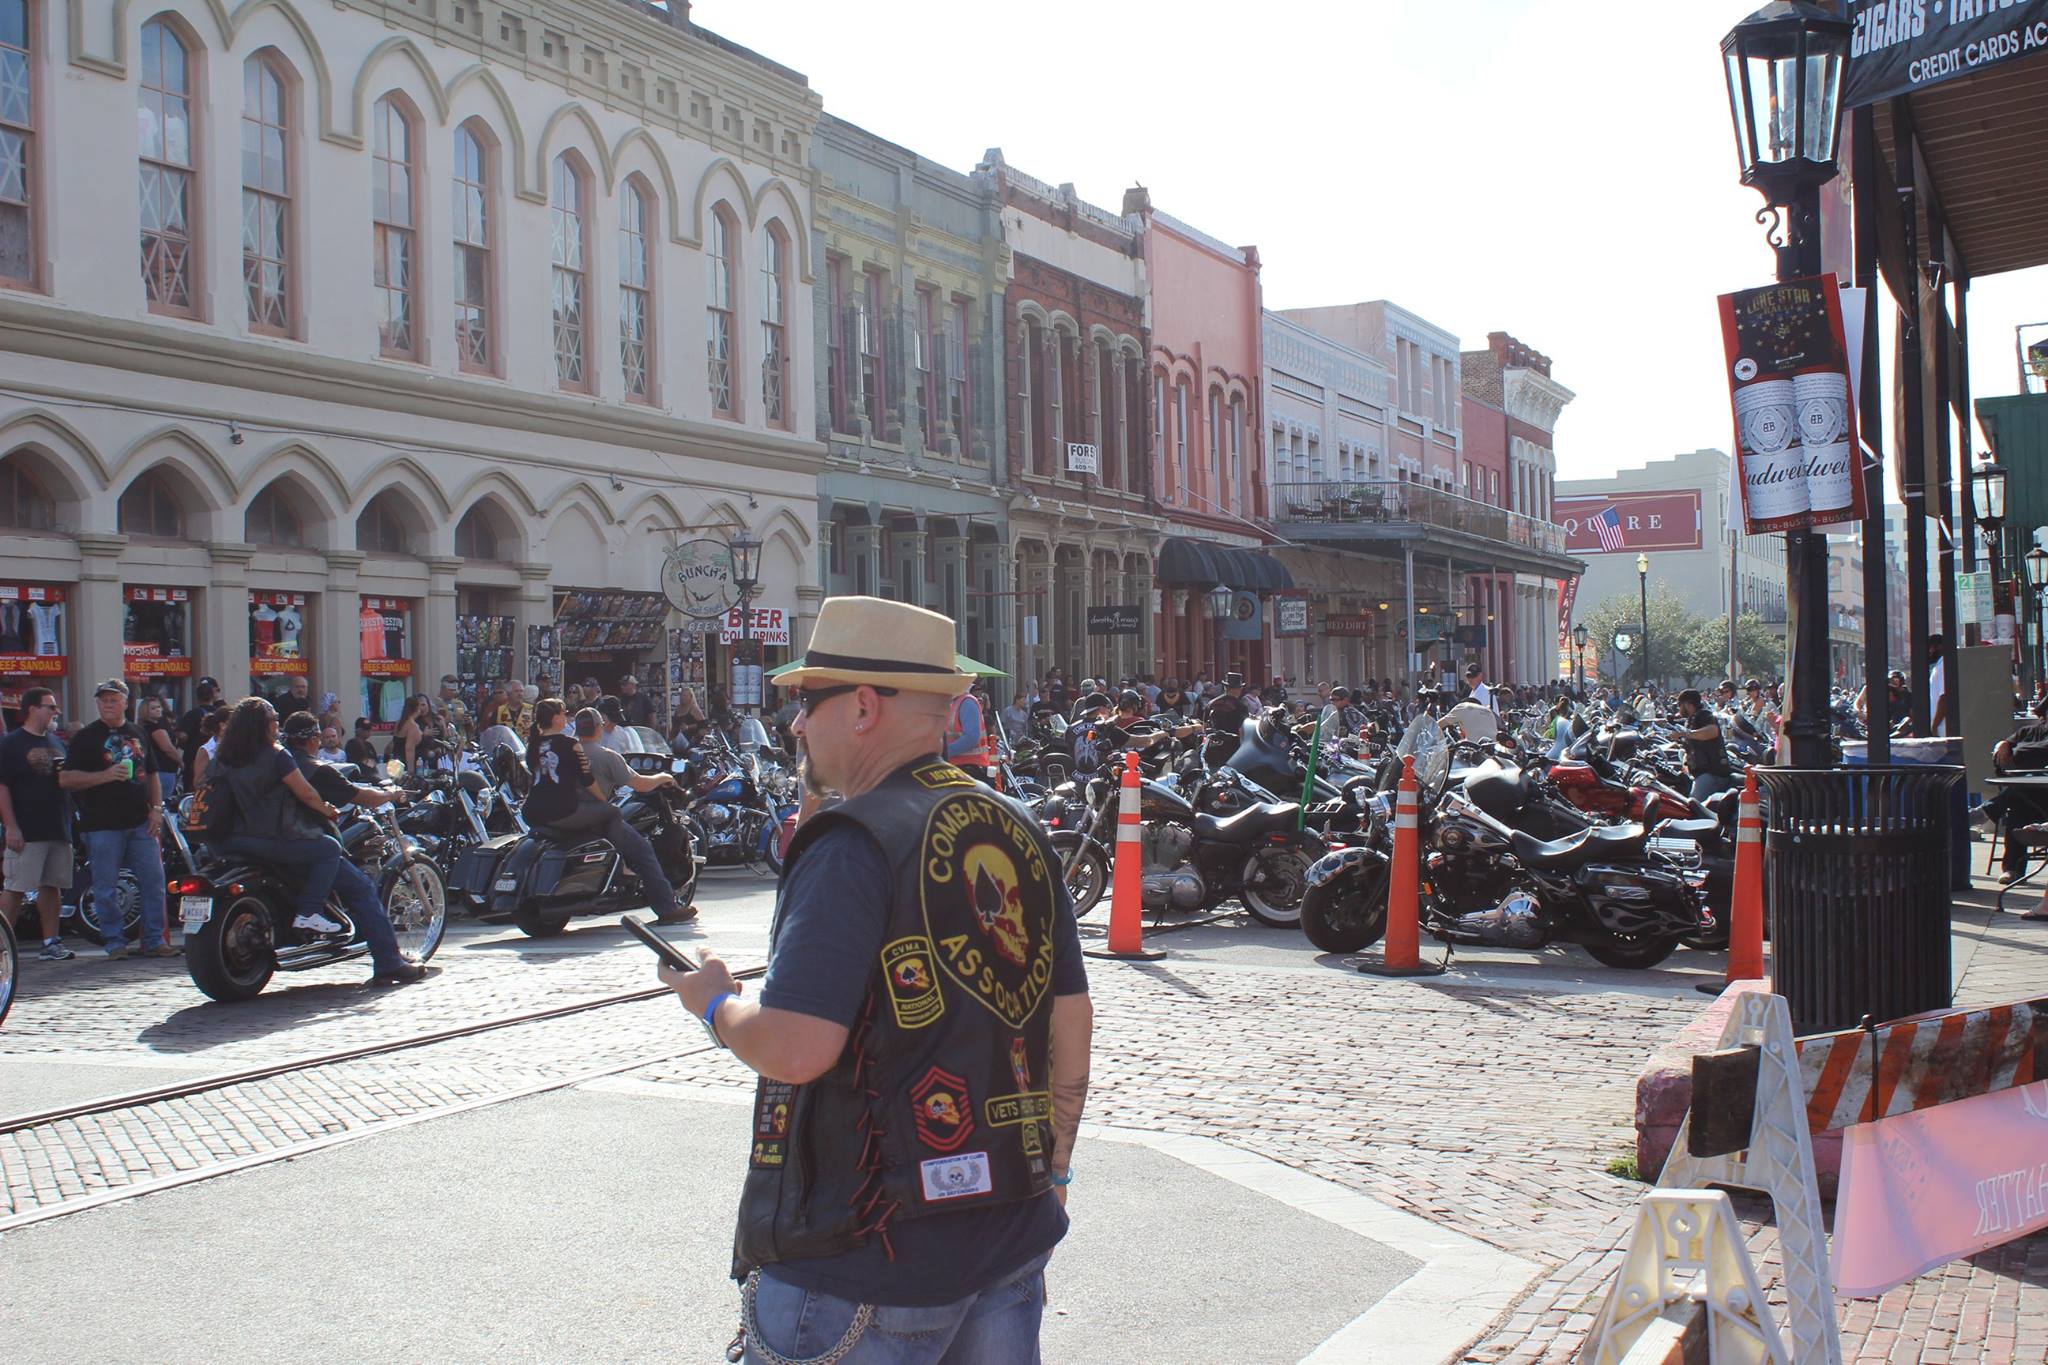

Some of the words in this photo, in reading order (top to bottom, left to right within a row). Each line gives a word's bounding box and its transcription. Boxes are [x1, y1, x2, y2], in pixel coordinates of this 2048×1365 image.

[1851, 0, 1926, 58] CIGARS
[1908, 47, 1960, 83] CREDIT
[1965, 30, 2020, 66] CARDS
[1778, 287, 1811, 304] STAR
[1563, 514, 1662, 537] QURE
[678, 564, 728, 584] BUNCH'A
[1960, 576, 1968, 588] 2
[688, 621, 720, 632] BEER
[753, 630, 788, 643] DRINKS
[20, 660, 61, 672] SANDALS
[130, 662, 151, 672] REEF
[154, 662, 191, 672] SANDALS
[255, 662, 273, 672] REEF
[276, 662, 307, 672] SANDALS
[363, 662, 381, 673] REEF
[382, 663, 411, 673] SANDALS
[929, 799, 992, 885] COMBAT
[996, 808, 1045, 882] VETS
[892, 942, 920, 957] CVMA
[901, 995, 935, 1010] NATIONAL
[991, 1101, 1019, 1119] VETS
